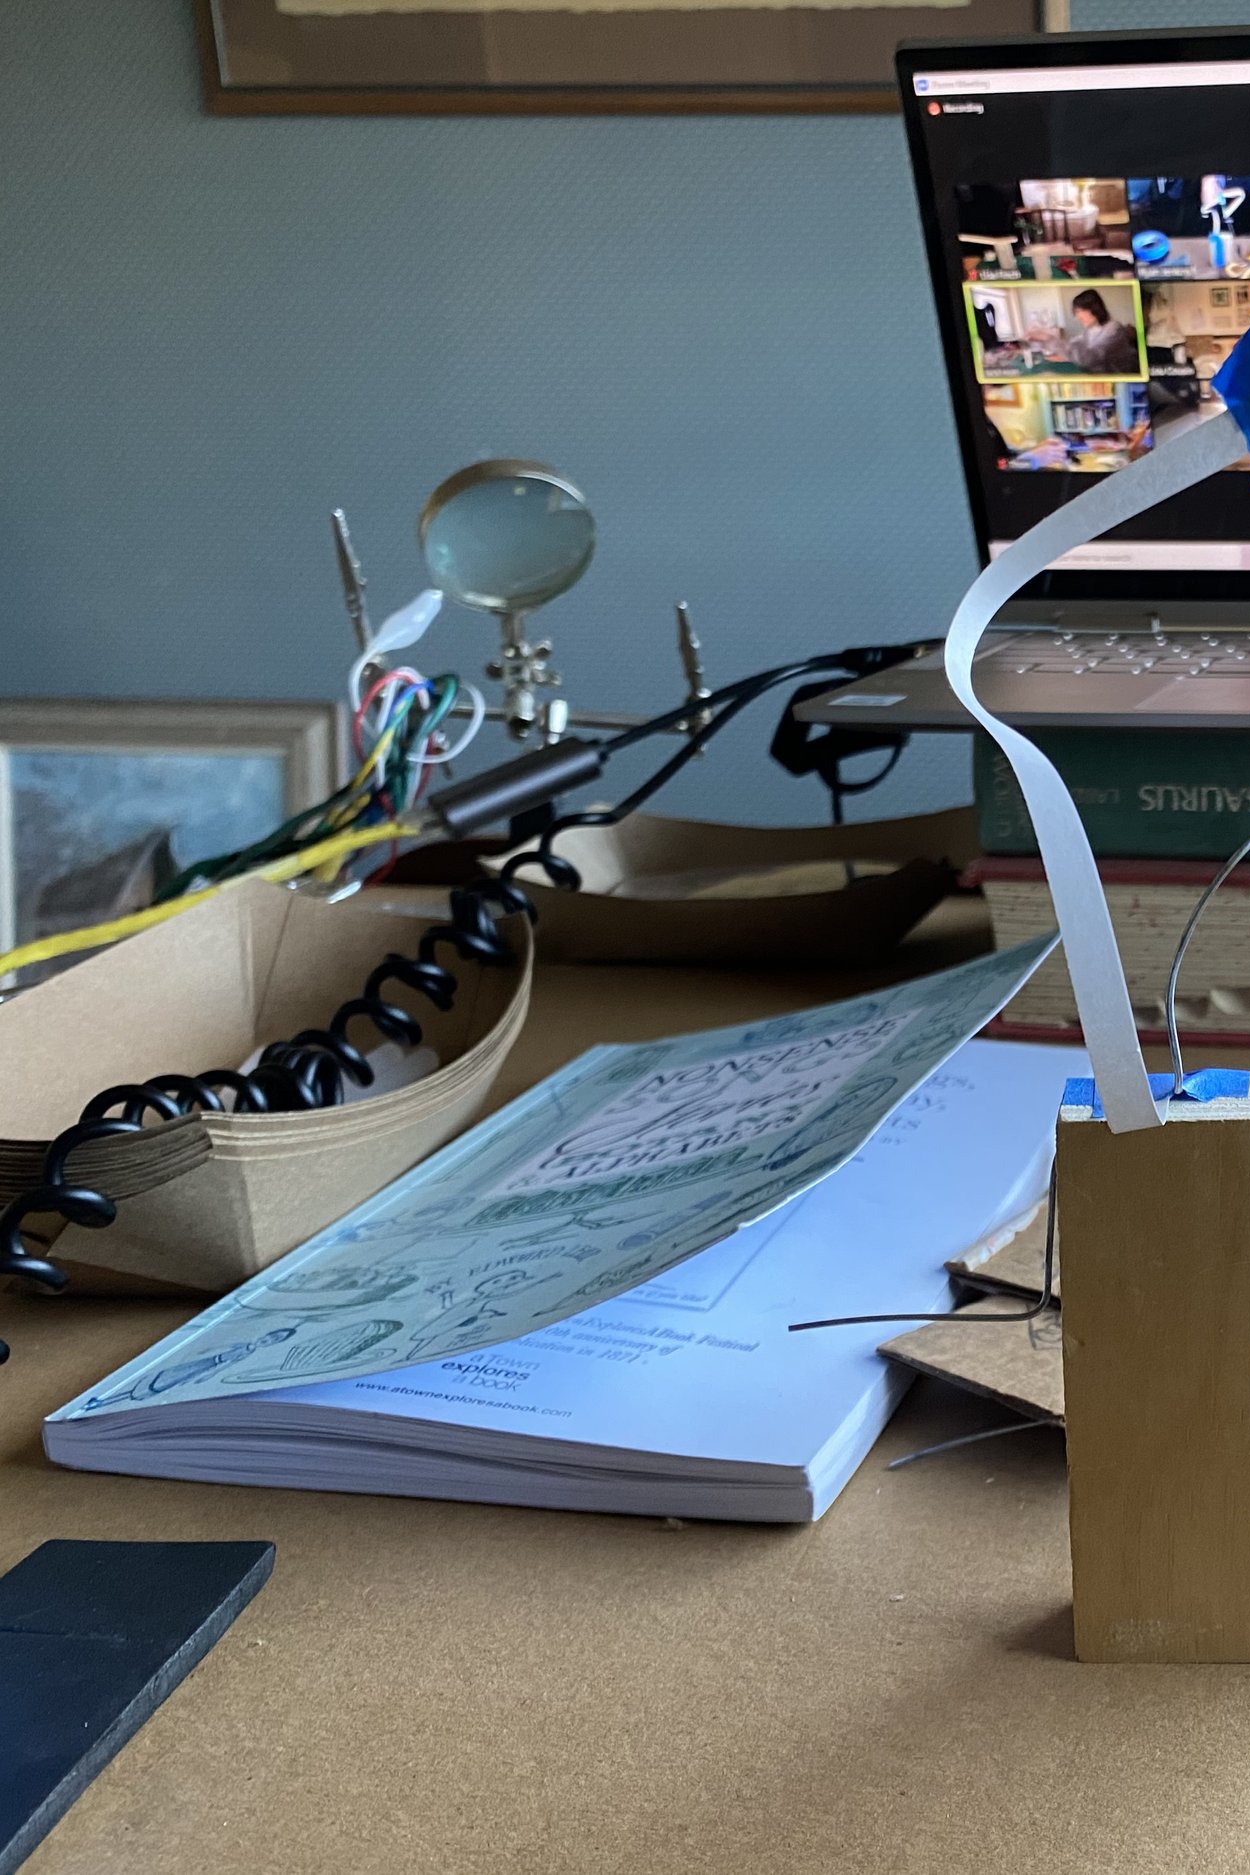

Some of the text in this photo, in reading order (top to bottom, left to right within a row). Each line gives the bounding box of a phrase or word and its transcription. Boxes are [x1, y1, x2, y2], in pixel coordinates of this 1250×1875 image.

[634, 1014, 908, 1096] NONSENSE
[604, 1038, 883, 1115] SONGS
[545, 1111, 801, 1185] ALPHABETS
[441, 1362, 530, 1381] explores
[487, 1354, 541, 1371] Town
[356, 1382, 572, 1419] www.atownexploresabook.com
[470, 1375, 521, 1392] book
